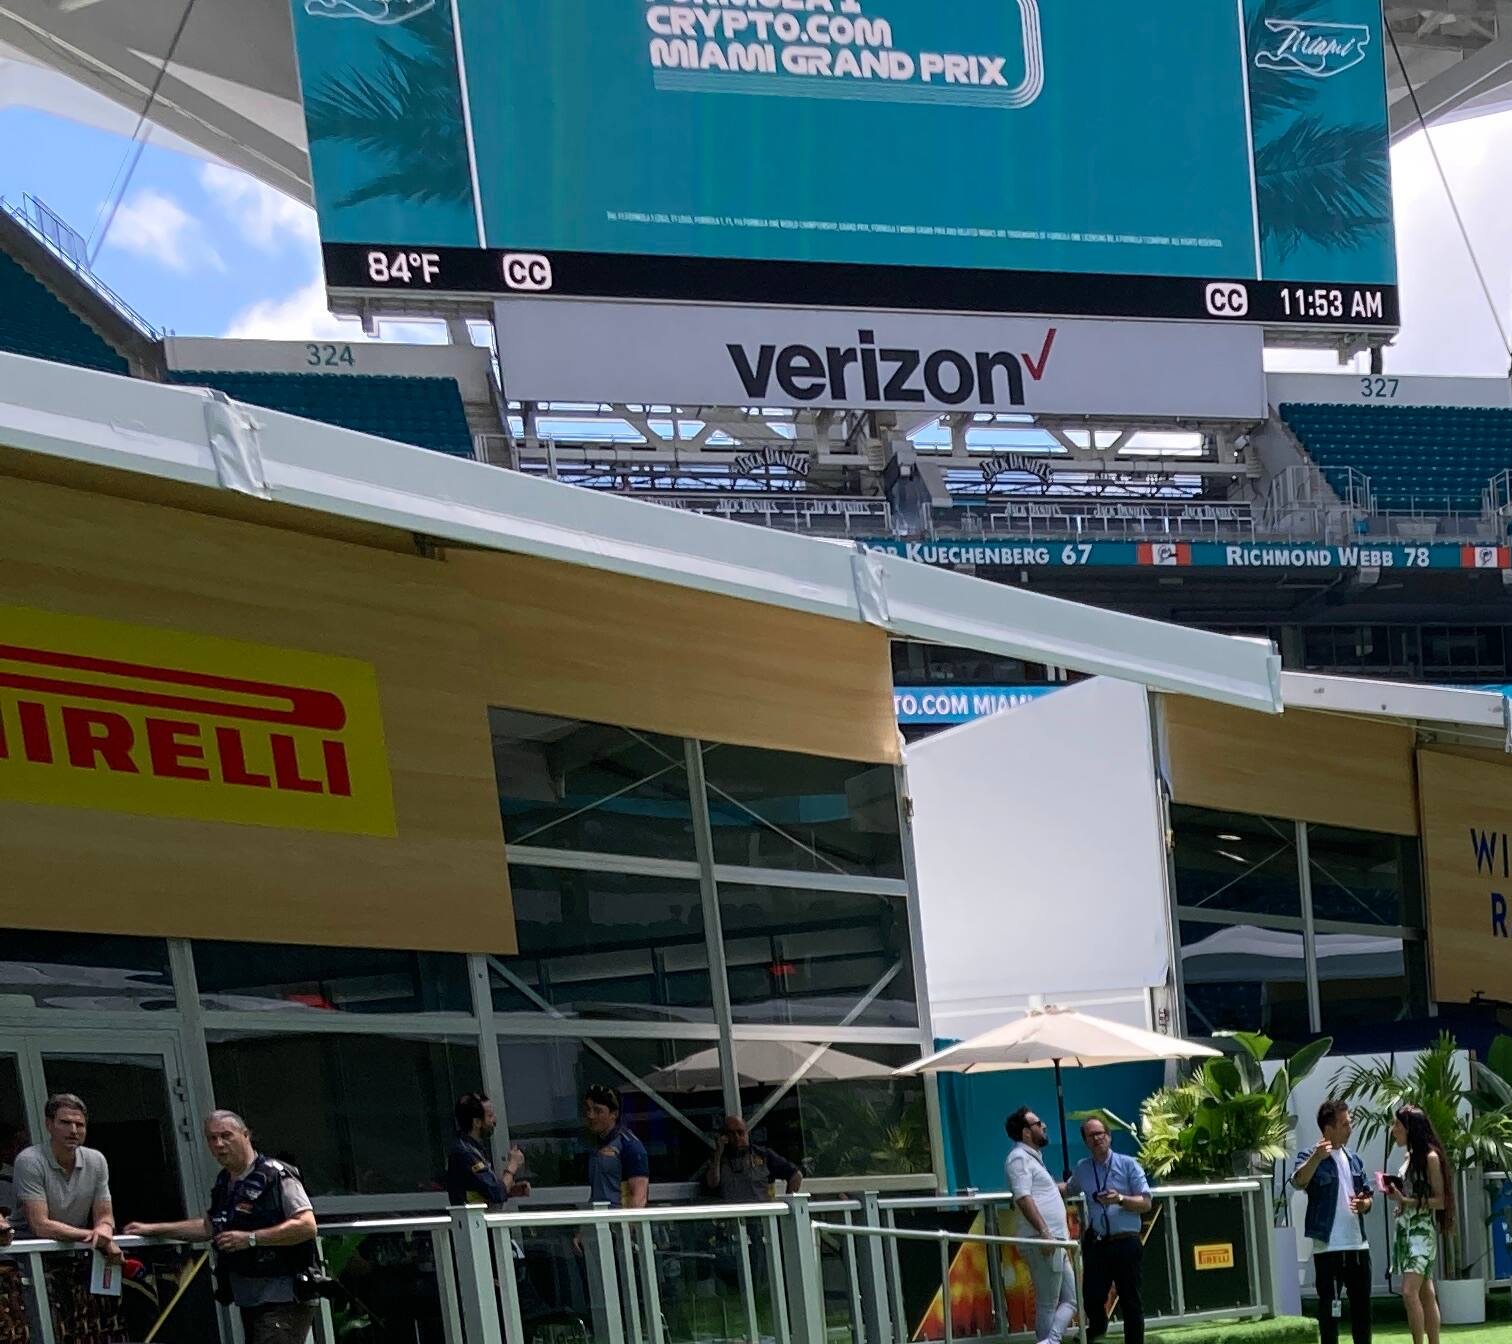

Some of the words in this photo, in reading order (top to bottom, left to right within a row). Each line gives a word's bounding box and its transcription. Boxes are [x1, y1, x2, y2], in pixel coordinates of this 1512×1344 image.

[646, 6, 893, 48] CRYPTO.COM
[1277, 30, 1356, 57] Miami
[650, 38, 776, 74] MIAMI
[781, 46, 914, 80] GRAND
[919, 52, 1009, 87] PRIX
[367, 250, 441, 285] 84°F
[508, 260, 548, 287] CC
[1210, 286, 1247, 314] CC
[1280, 288, 1344, 317] 11:53
[1351, 291, 1383, 318] AM
[305, 343, 355, 367] 324
[726, 329, 1025, 406] verizon
[1361, 376, 1399, 399] 327
[981, 456, 1009, 480] JACK
[906, 543, 1050, 566] KUECHENBERG
[1061, 544, 1093, 566] 67
[1226, 545, 1331, 567] RICHMOND
[1338, 546, 1394, 567] WEBB
[1404, 547, 1430, 567] 78
[973, 695, 1034, 715] MIAM
